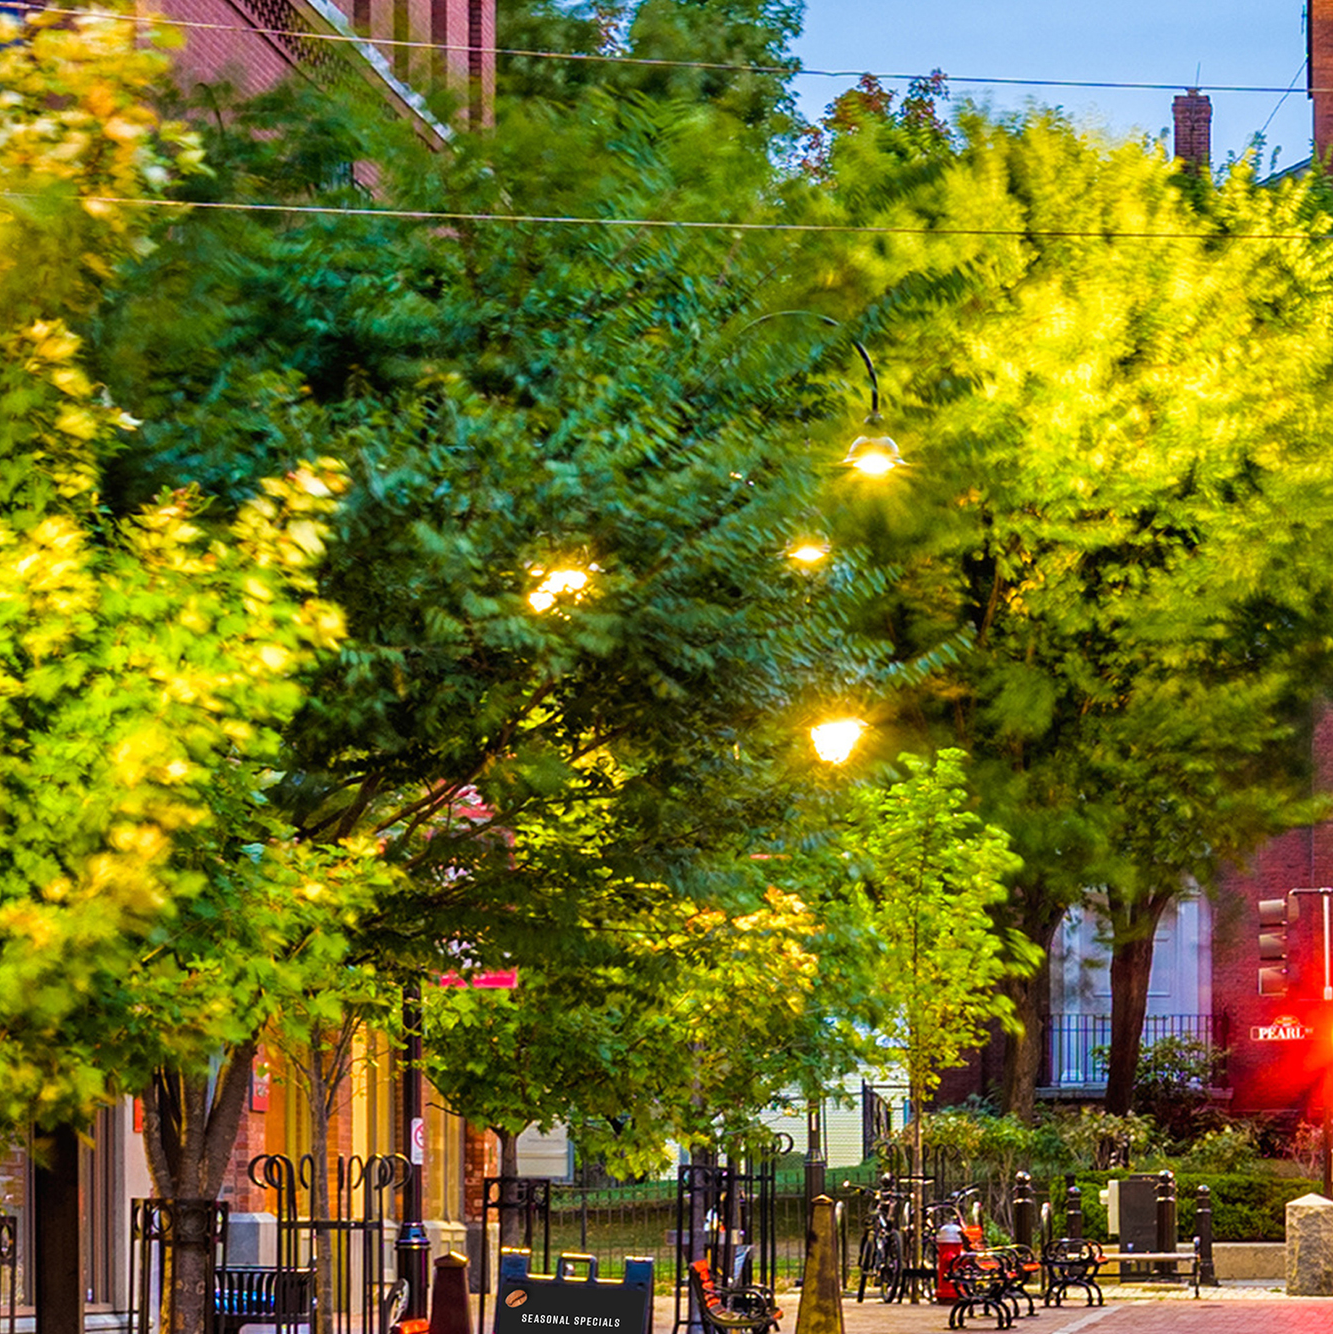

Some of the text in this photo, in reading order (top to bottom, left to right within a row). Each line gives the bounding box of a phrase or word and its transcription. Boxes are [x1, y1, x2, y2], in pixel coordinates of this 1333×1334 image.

[1259, 1027, 1305, 1040] PEARL
[521, 1313, 621, 1328] SEASONAL SPECIALS
